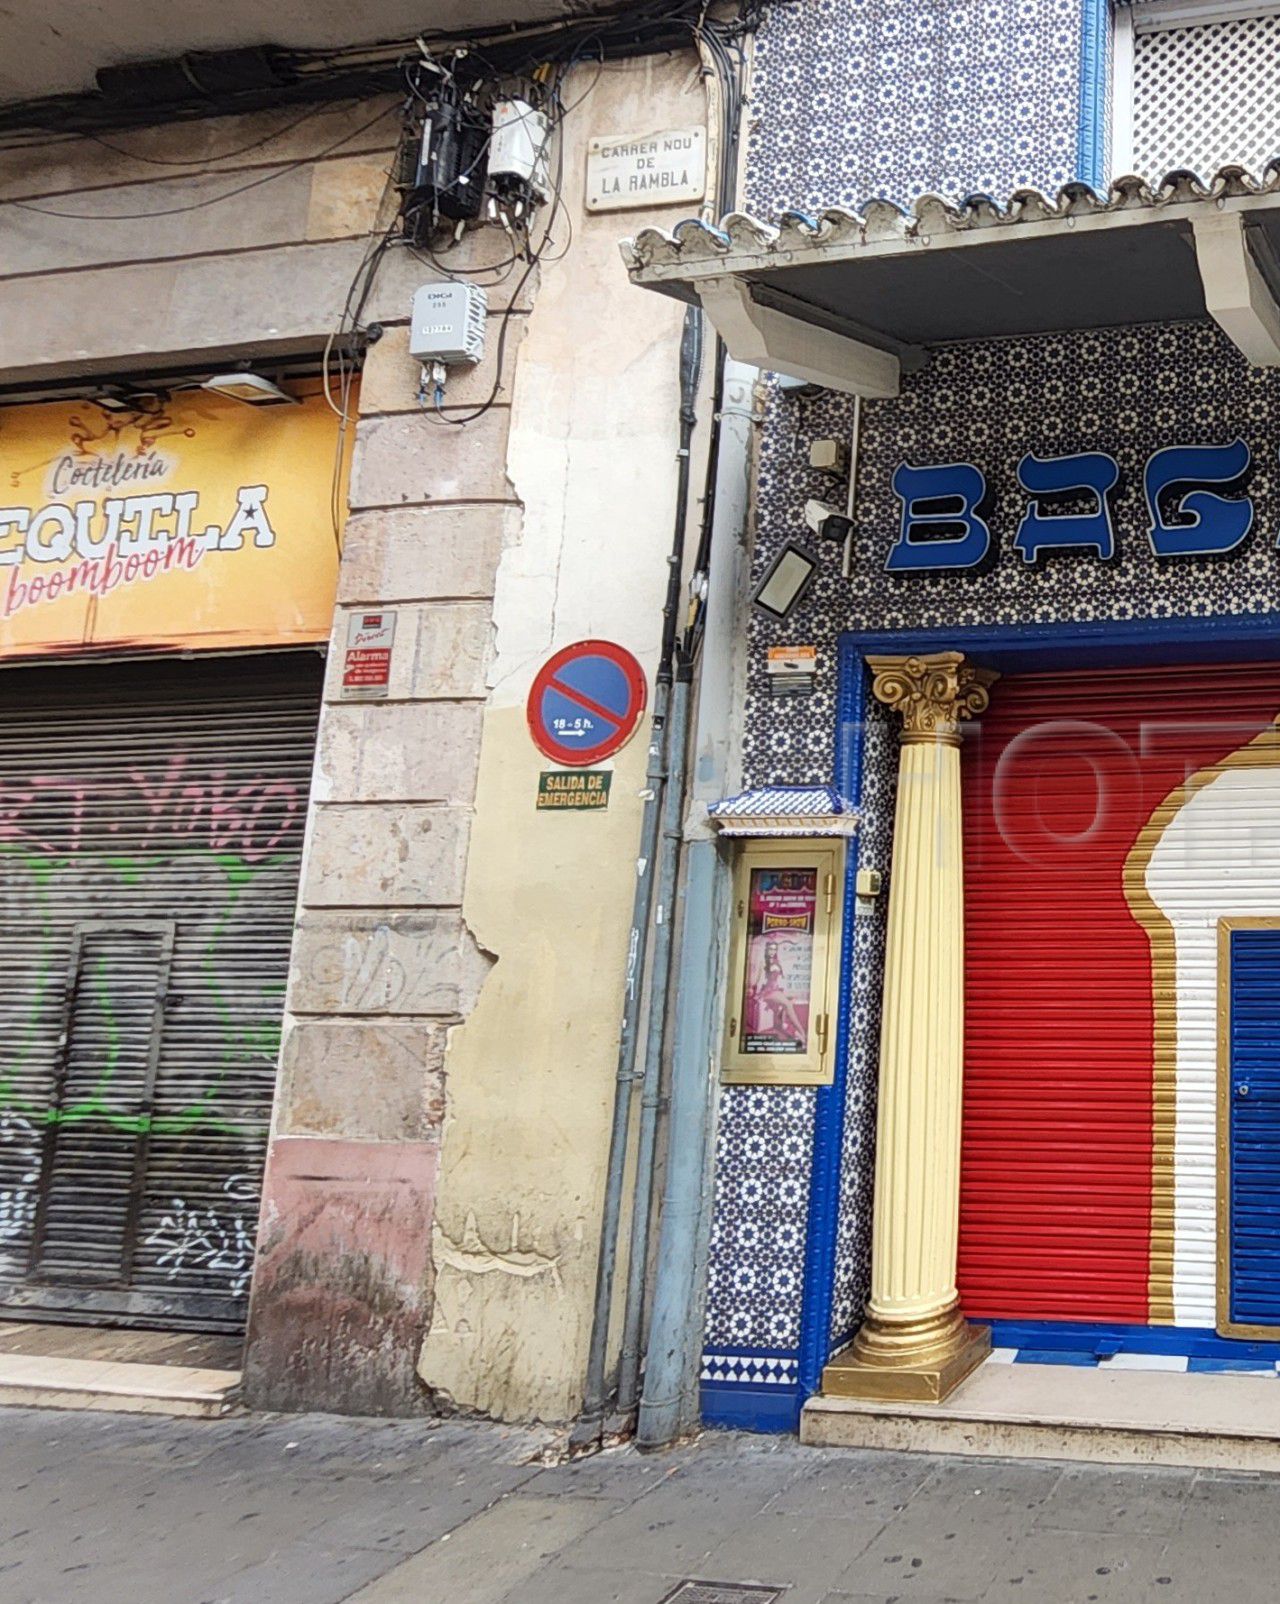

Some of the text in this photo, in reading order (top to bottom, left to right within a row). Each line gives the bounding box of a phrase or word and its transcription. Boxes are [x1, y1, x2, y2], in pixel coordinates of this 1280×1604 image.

[601, 138, 692, 158] CARRER NOU
[637, 157, 656, 169] DE
[602, 170, 689, 194] LA RAMBLA
[52, 451, 169, 495] Coctelería
[347, 651, 389, 662] Alarma
[553, 718, 565, 729] 18
[546, 774, 604, 790] SALIDA DE
[537, 790, 608, 807] EMERGENCIA
